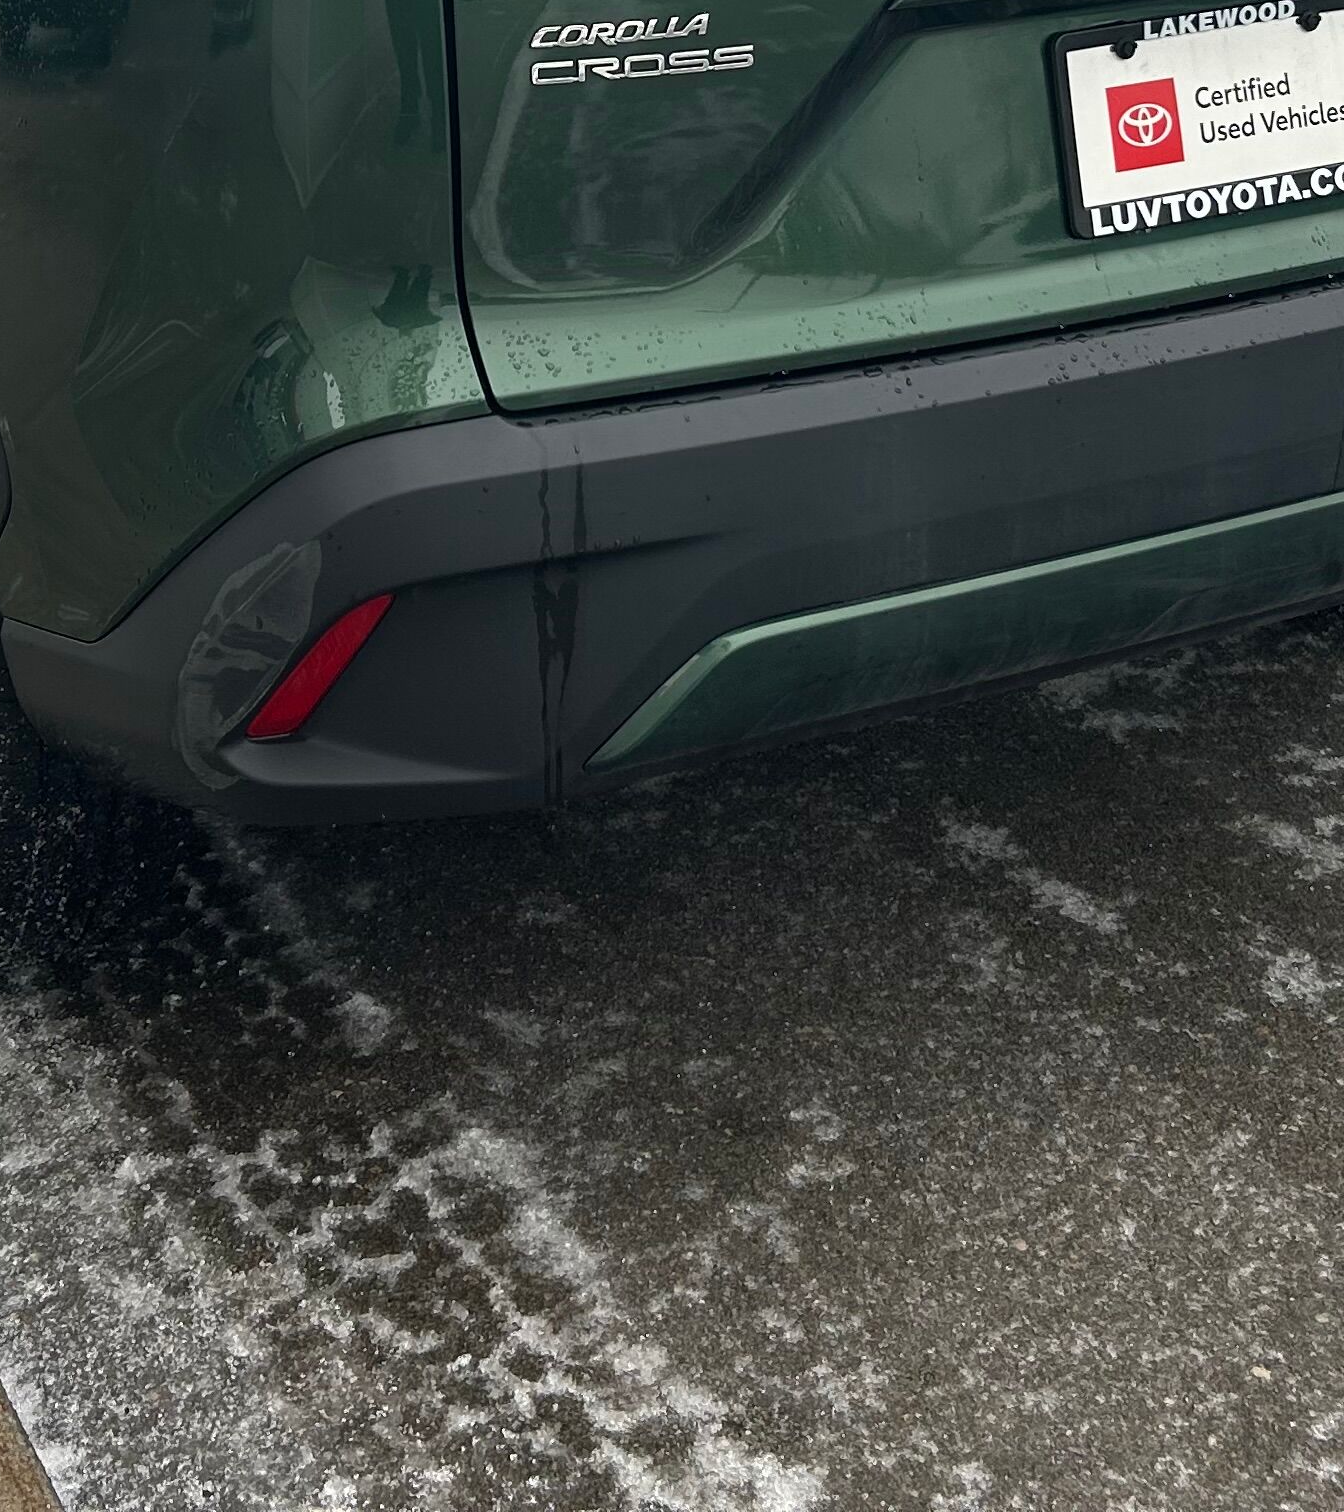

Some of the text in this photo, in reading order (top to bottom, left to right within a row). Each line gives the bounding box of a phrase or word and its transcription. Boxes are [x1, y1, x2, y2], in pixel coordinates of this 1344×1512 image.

[530, 13, 710, 48] COROLLA
[1143, 0, 1296, 40] LAKEWOOD
[531, 44, 754, 85] CROSS
[1194, 73, 1291, 109] Certified
[1199, 112, 1256, 144] Used
